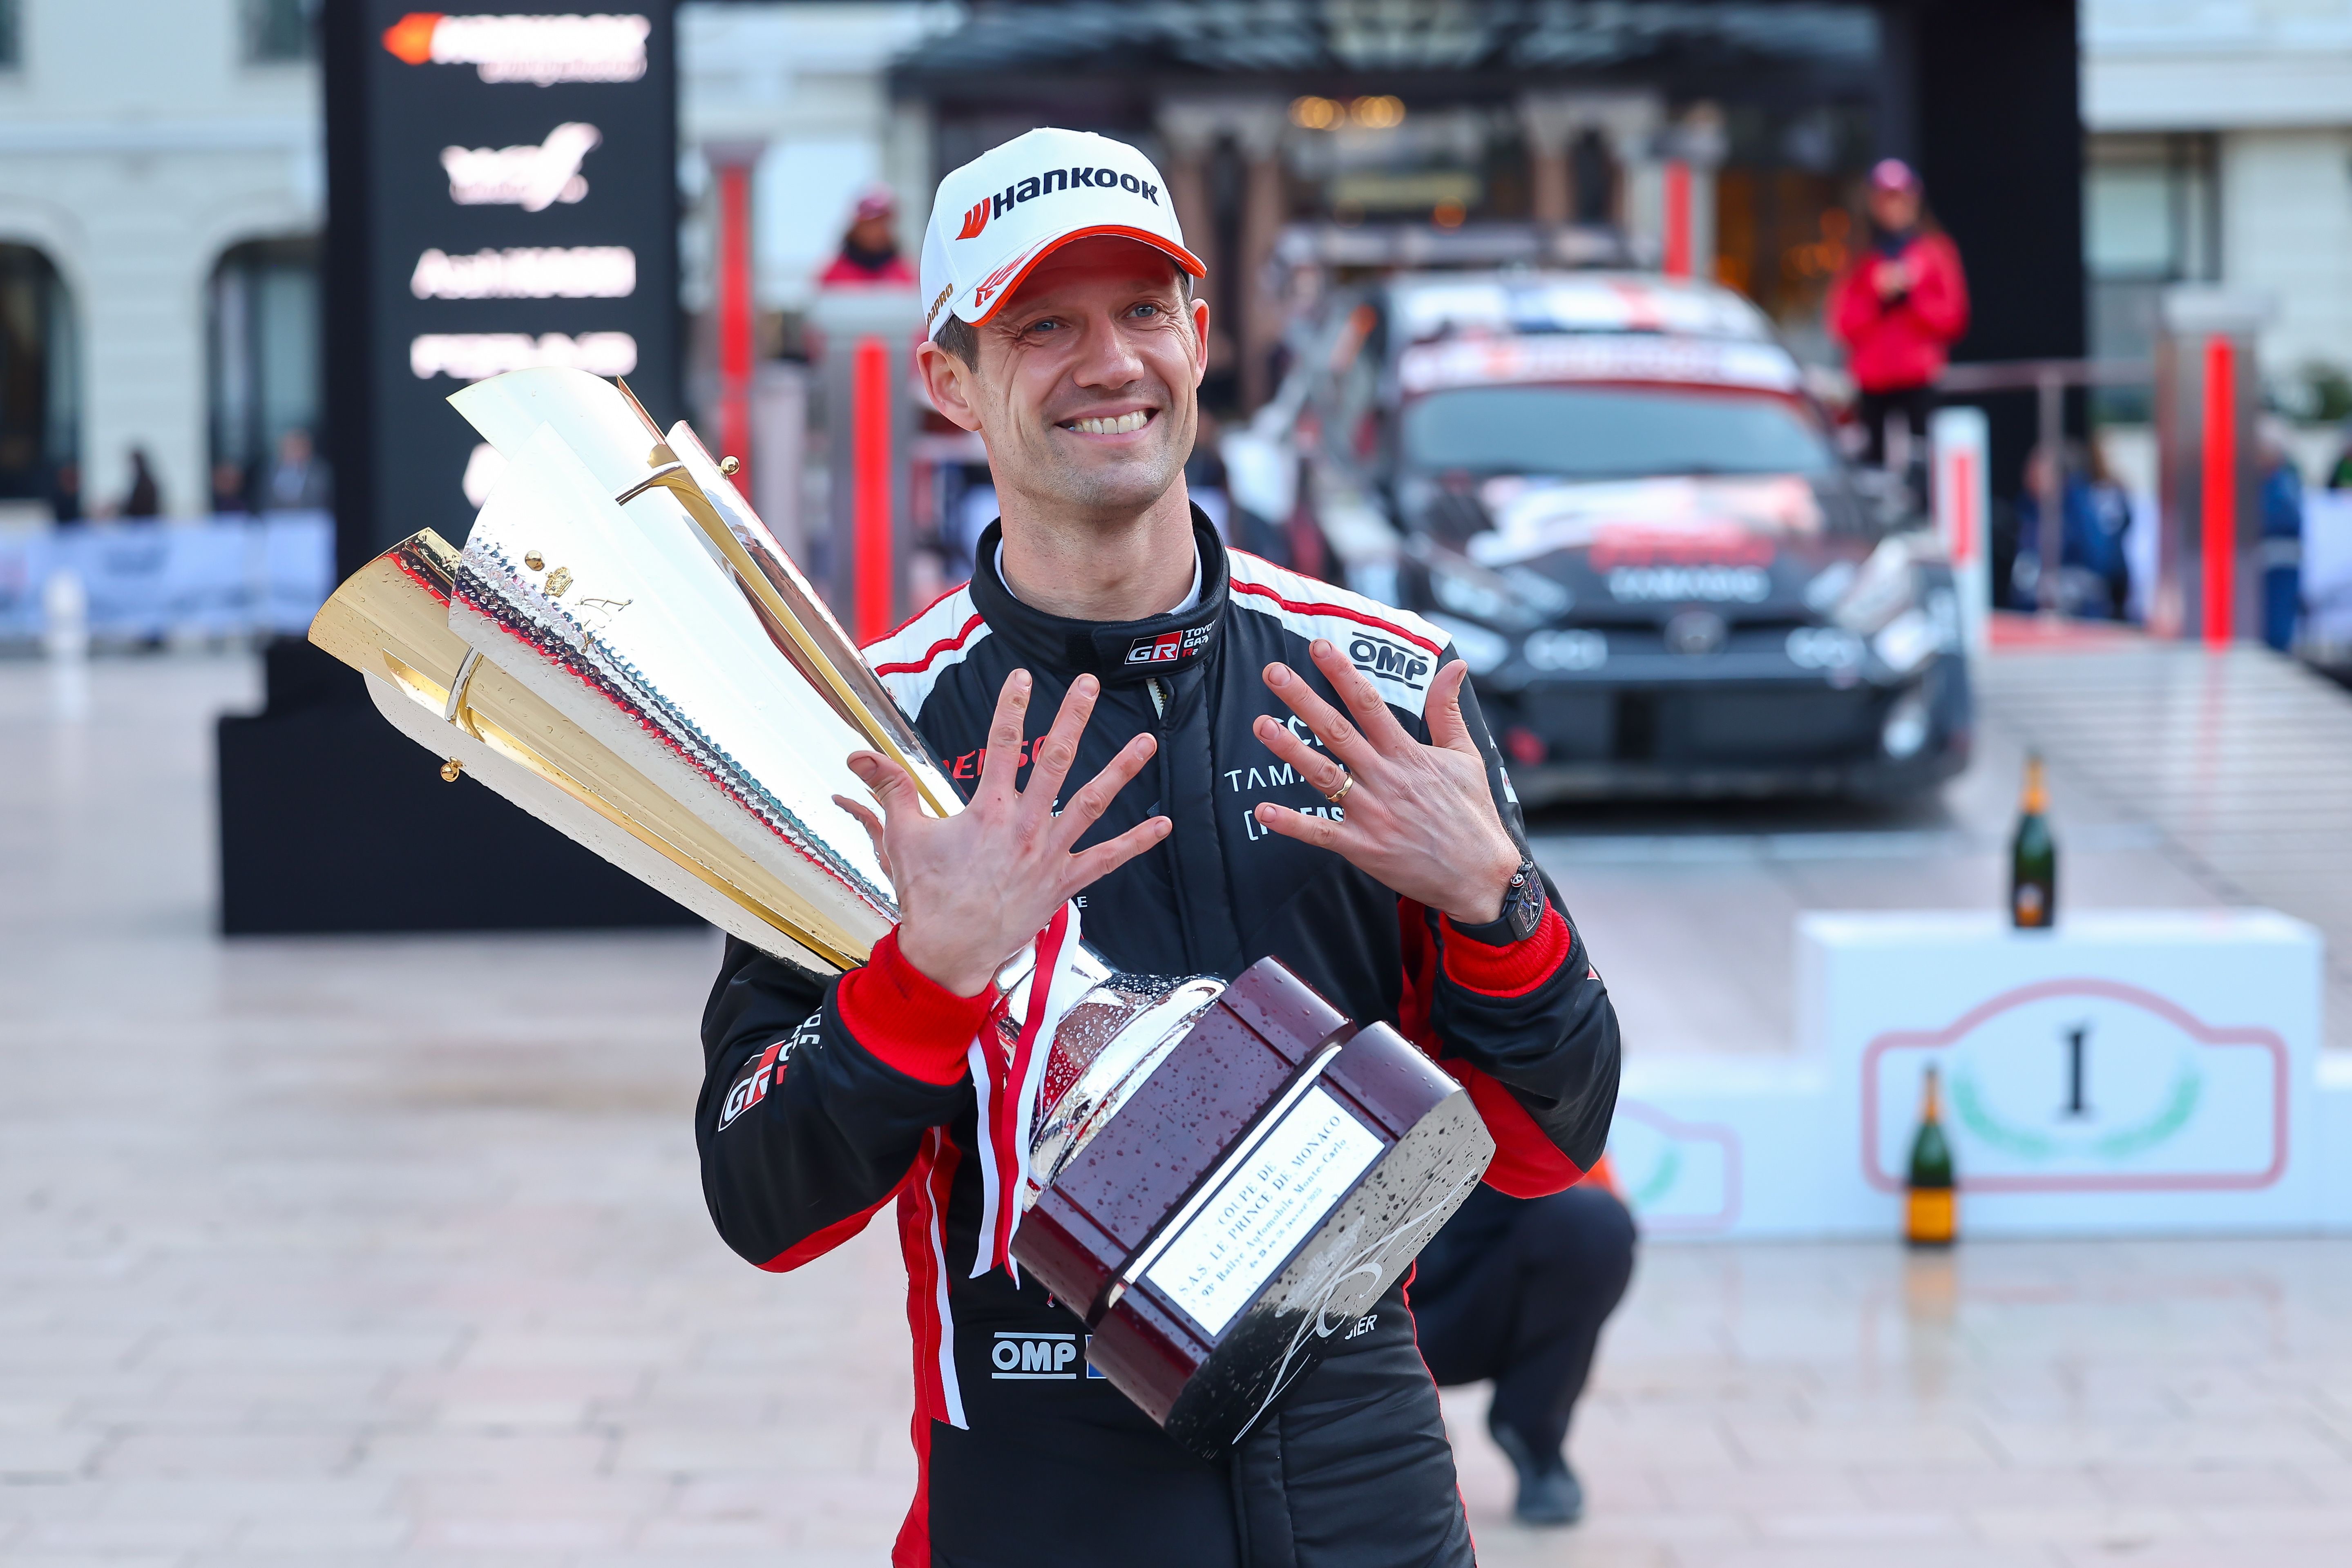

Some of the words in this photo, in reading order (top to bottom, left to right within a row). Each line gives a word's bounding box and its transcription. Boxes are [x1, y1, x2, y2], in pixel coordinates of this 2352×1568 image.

[1128, 643, 1177, 661] GR
[1349, 639, 1428, 681] OMP
[1208, 1240, 1229, 1261] LE
[1227, 1191, 1273, 1240] PRINCE
[1271, 1169, 1292, 1192] DE
[1290, 1115, 1340, 1169] MONACO
[1217, 1182, 1258, 1225] COUPE
[1256, 1160, 1277, 1182] DE
[1215, 1251, 1245, 1282] Rallye
[1245, 1197, 1294, 1250] Automobile
[992, 1340, 1076, 1371] OMP
